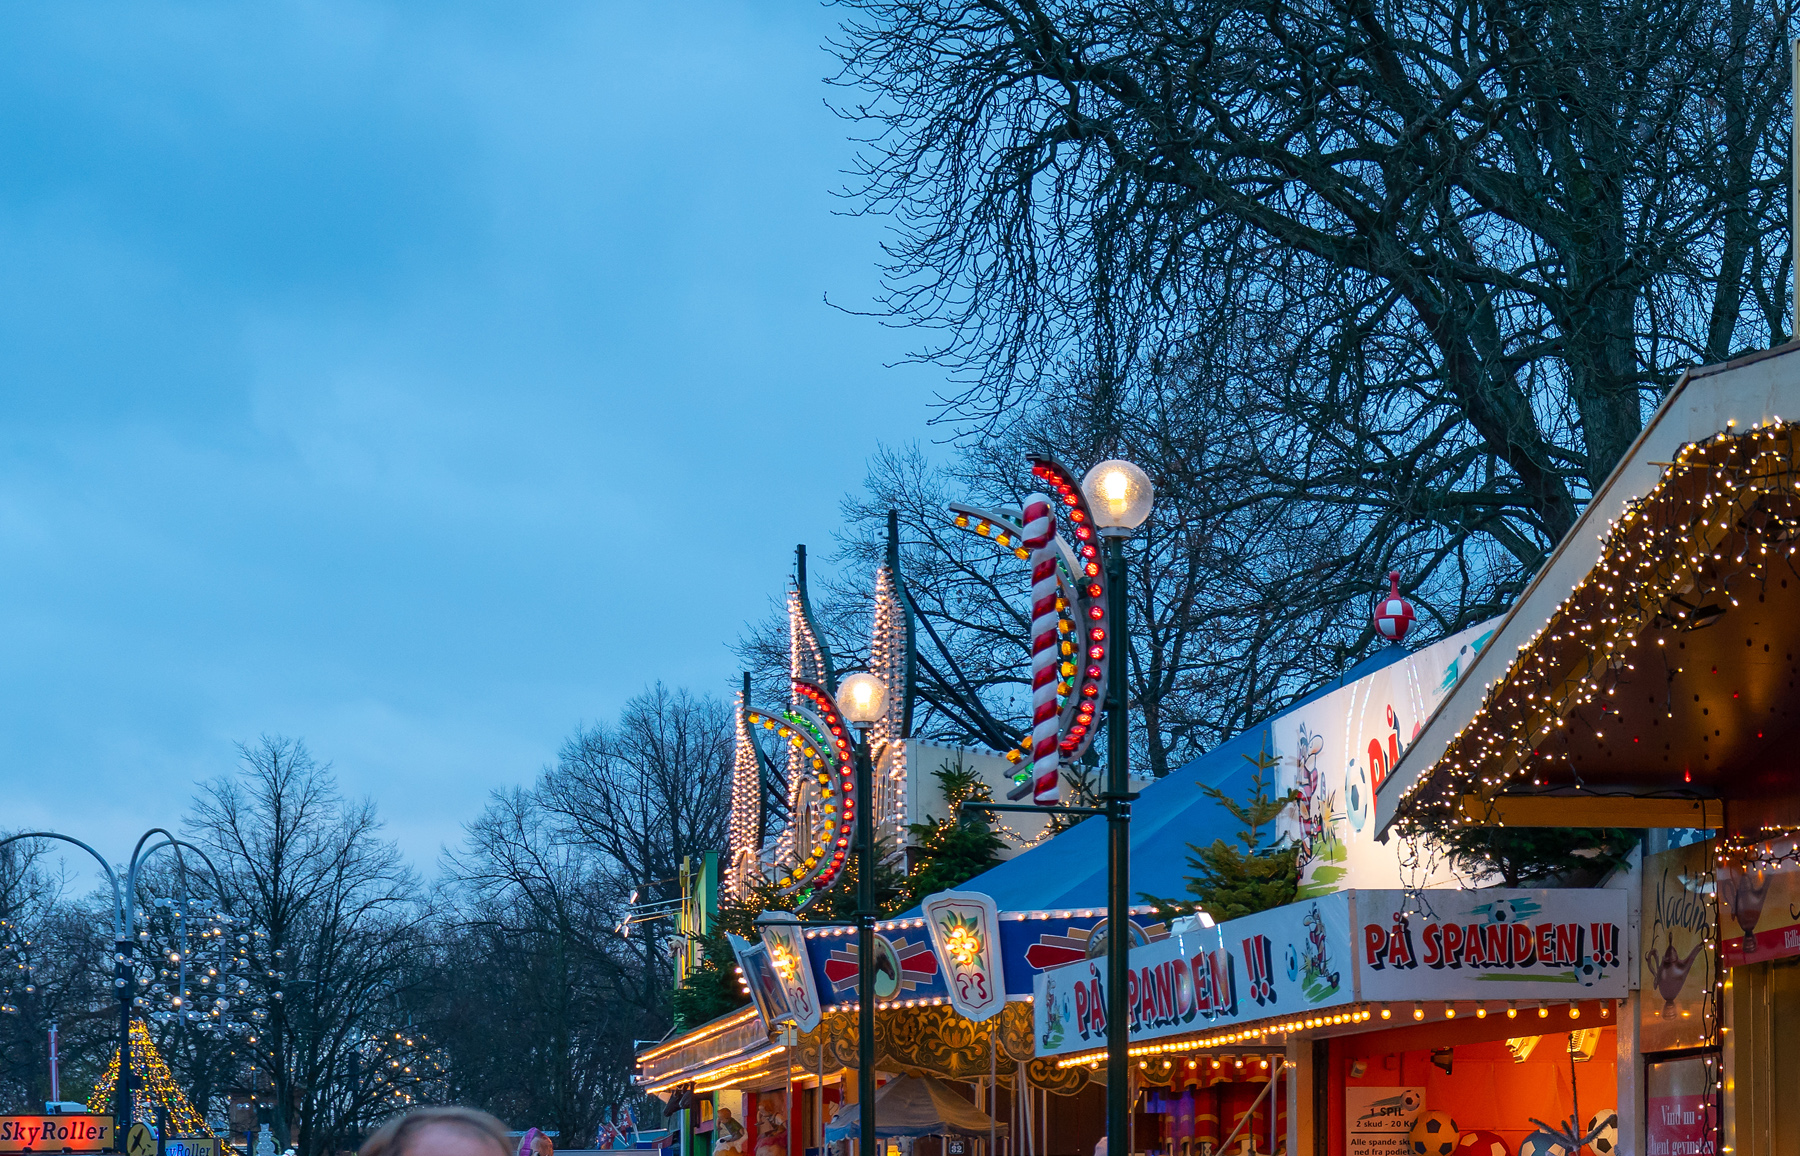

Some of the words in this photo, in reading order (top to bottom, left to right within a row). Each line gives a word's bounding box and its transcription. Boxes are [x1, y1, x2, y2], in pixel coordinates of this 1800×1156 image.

[1364, 912, 1412, 968] PÅ
[1422, 922, 1581, 968] SPANDEN
[1074, 962, 1106, 1036] PÅ
[1128, 949, 1234, 1027] PANDEN
[1370, 1108, 1375, 1116] 1
[1380, 1107, 1405, 1117] SPIL
[1661, 1104, 1681, 1126] Vind
[1683, 1111, 1695, 1125] nu
[1, 1121, 108, 1145] SkyRoller
[1350, 1138, 1367, 1146] Alle
[1369, 1138, 1397, 1147] spande
[951, 1145, 963, 1153] 32
[1385, 1149, 1410, 1156] podiet
[1650, 1135, 1669, 1155] hent
